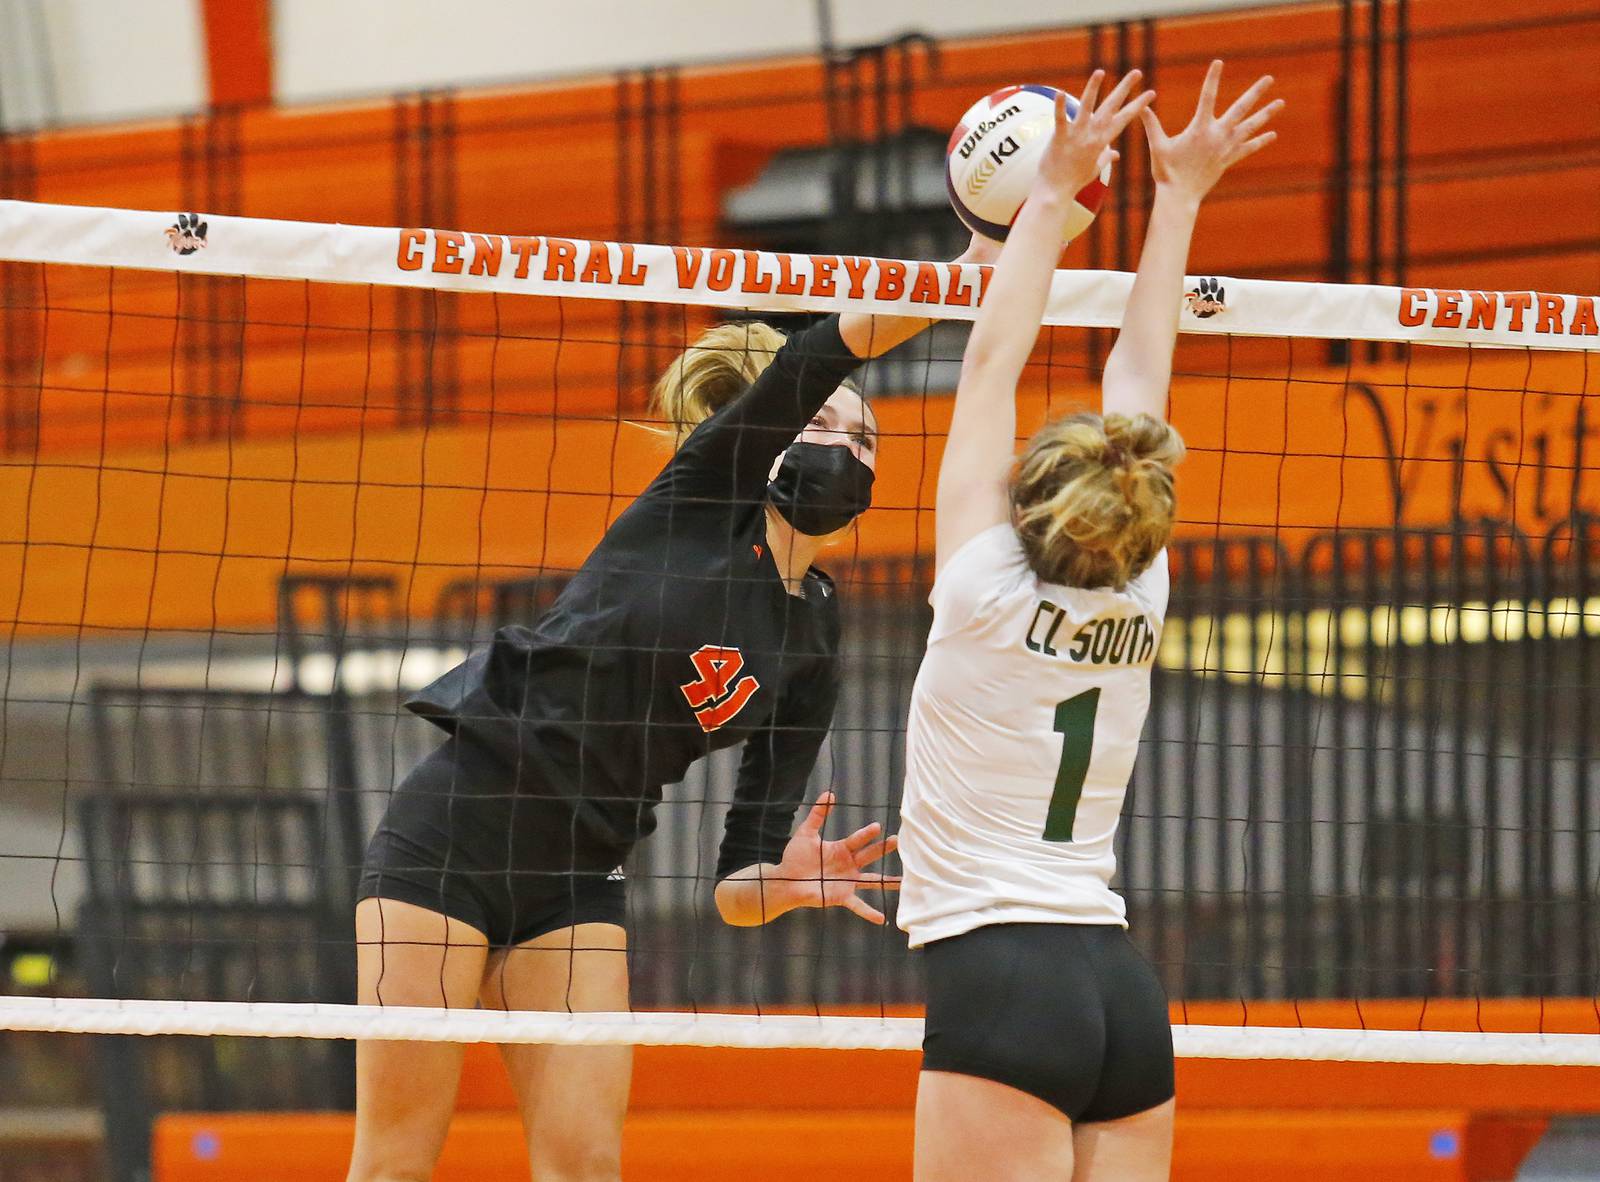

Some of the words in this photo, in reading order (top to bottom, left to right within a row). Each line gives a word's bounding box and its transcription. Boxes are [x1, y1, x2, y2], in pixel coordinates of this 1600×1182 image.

[958, 104, 1022, 159] Wilson
[396, 227, 648, 286] CENTRAL
[1398, 287, 1600, 336] CENTRA
[1025, 600, 1068, 657] CL
[1069, 614, 1154, 665] SOUTH
[1042, 686, 1102, 842] 1
